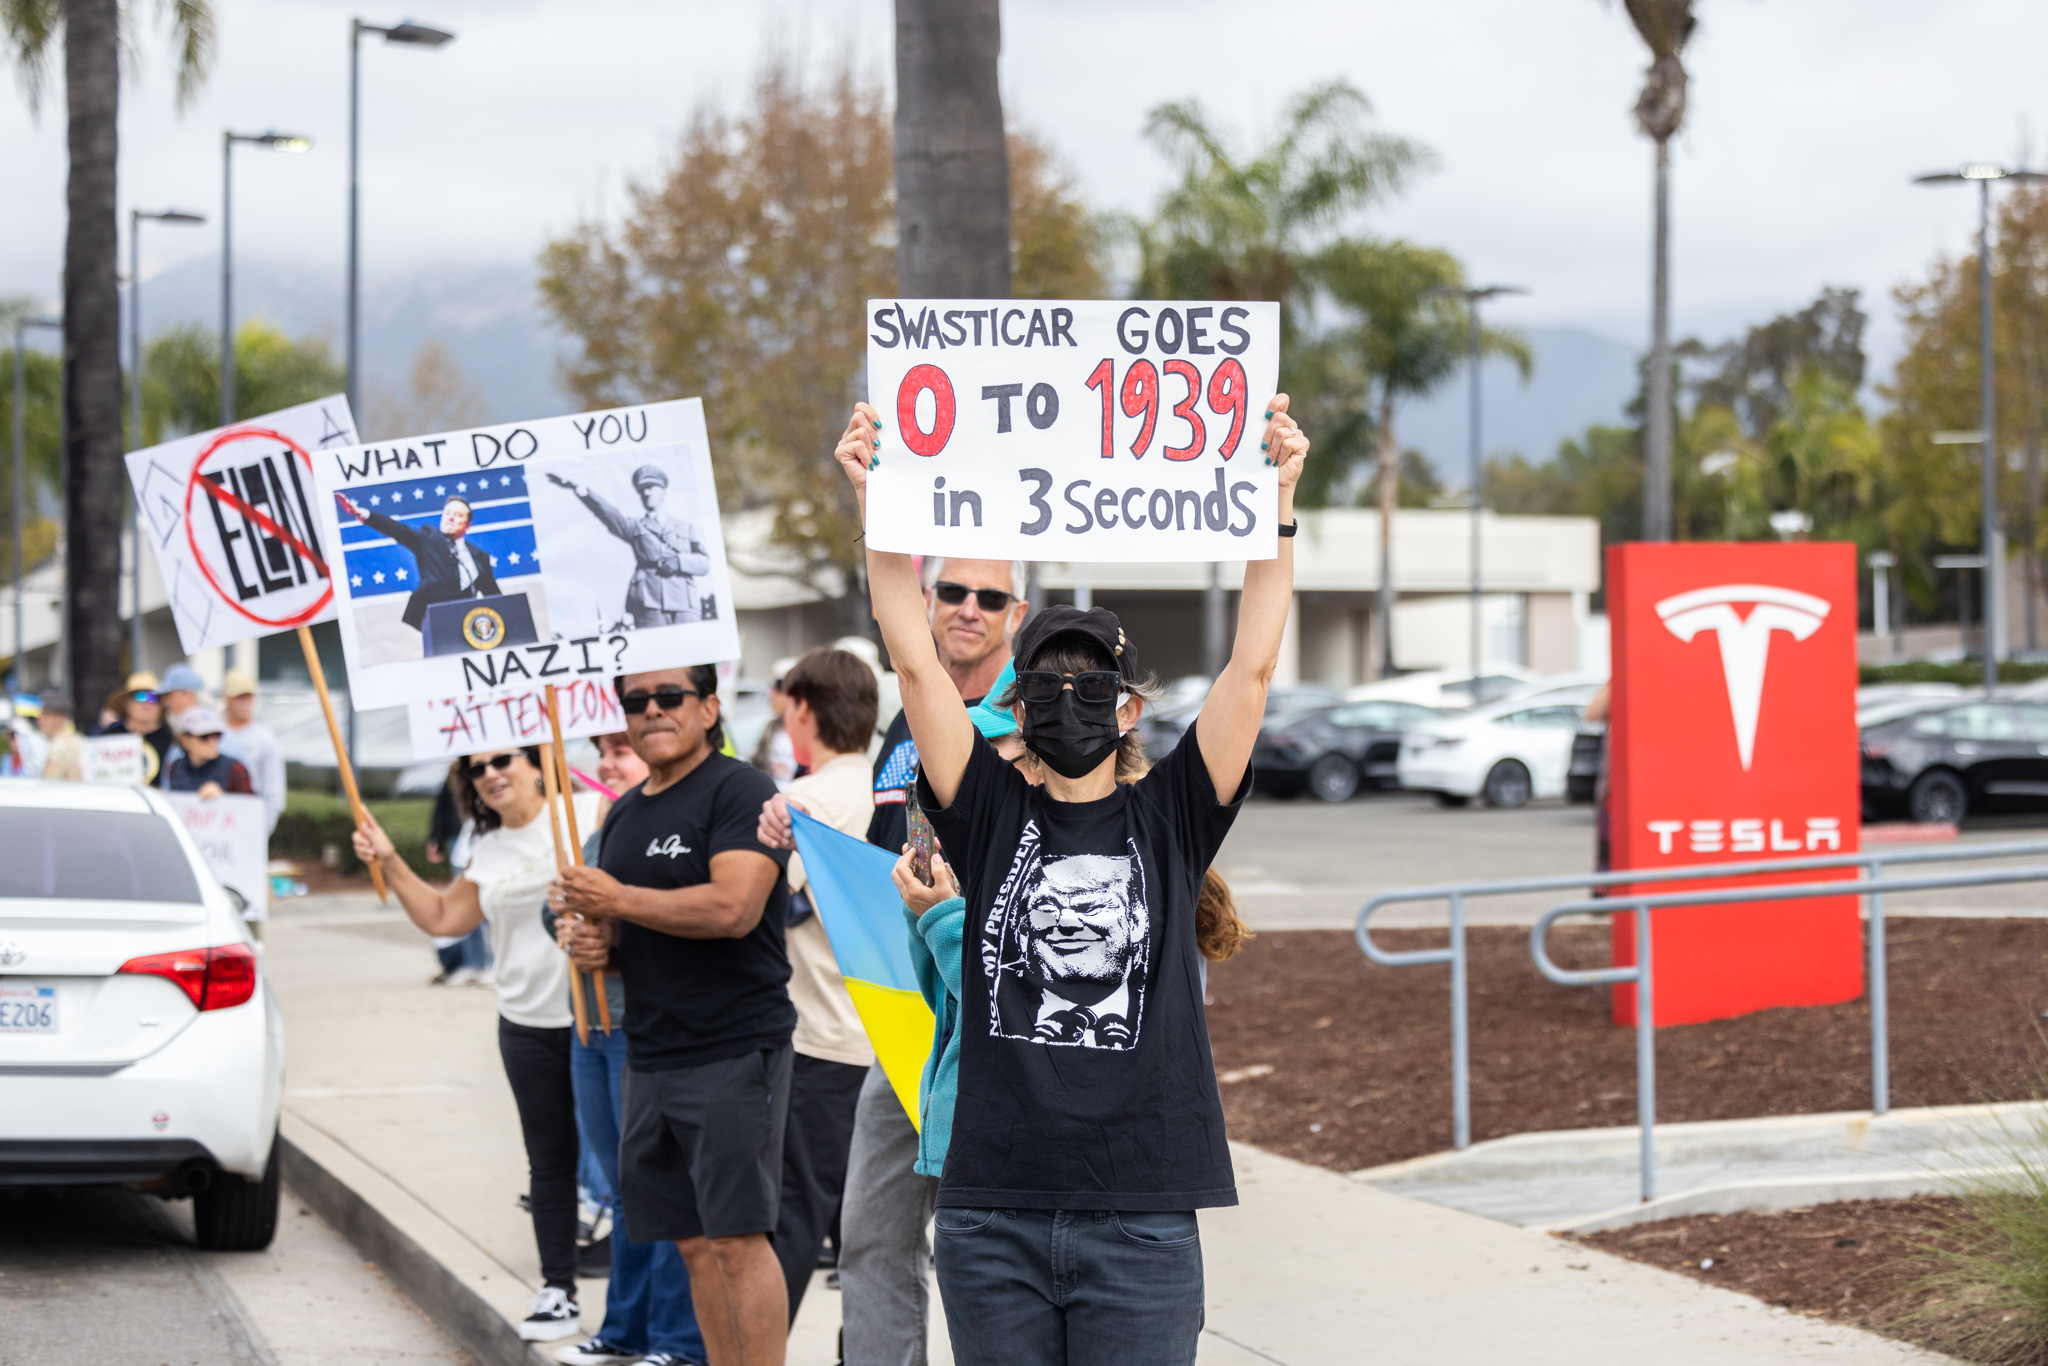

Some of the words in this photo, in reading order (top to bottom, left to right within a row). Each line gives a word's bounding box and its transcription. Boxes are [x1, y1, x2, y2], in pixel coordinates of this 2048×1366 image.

[870, 302, 1078, 350] SWASTICAR
[1116, 306, 1251, 355] GOES
[896, 363, 956, 457] 0
[981, 382, 1060, 434] TO
[1084, 356, 1249, 462] 1939
[336, 439, 447, 481] WHAT
[471, 428, 538, 468] DO
[573, 410, 648, 449] YOU
[933, 475, 983, 527] in
[1018, 467, 1053, 536] 3
[1064, 467, 1258, 537] Seconds
[461, 635, 628, 692] NAZI?
[1646, 817, 1841, 855] TESLA
[984, 819, 1041, 936] PRESIDENT
[981, 938, 998, 978] MY
